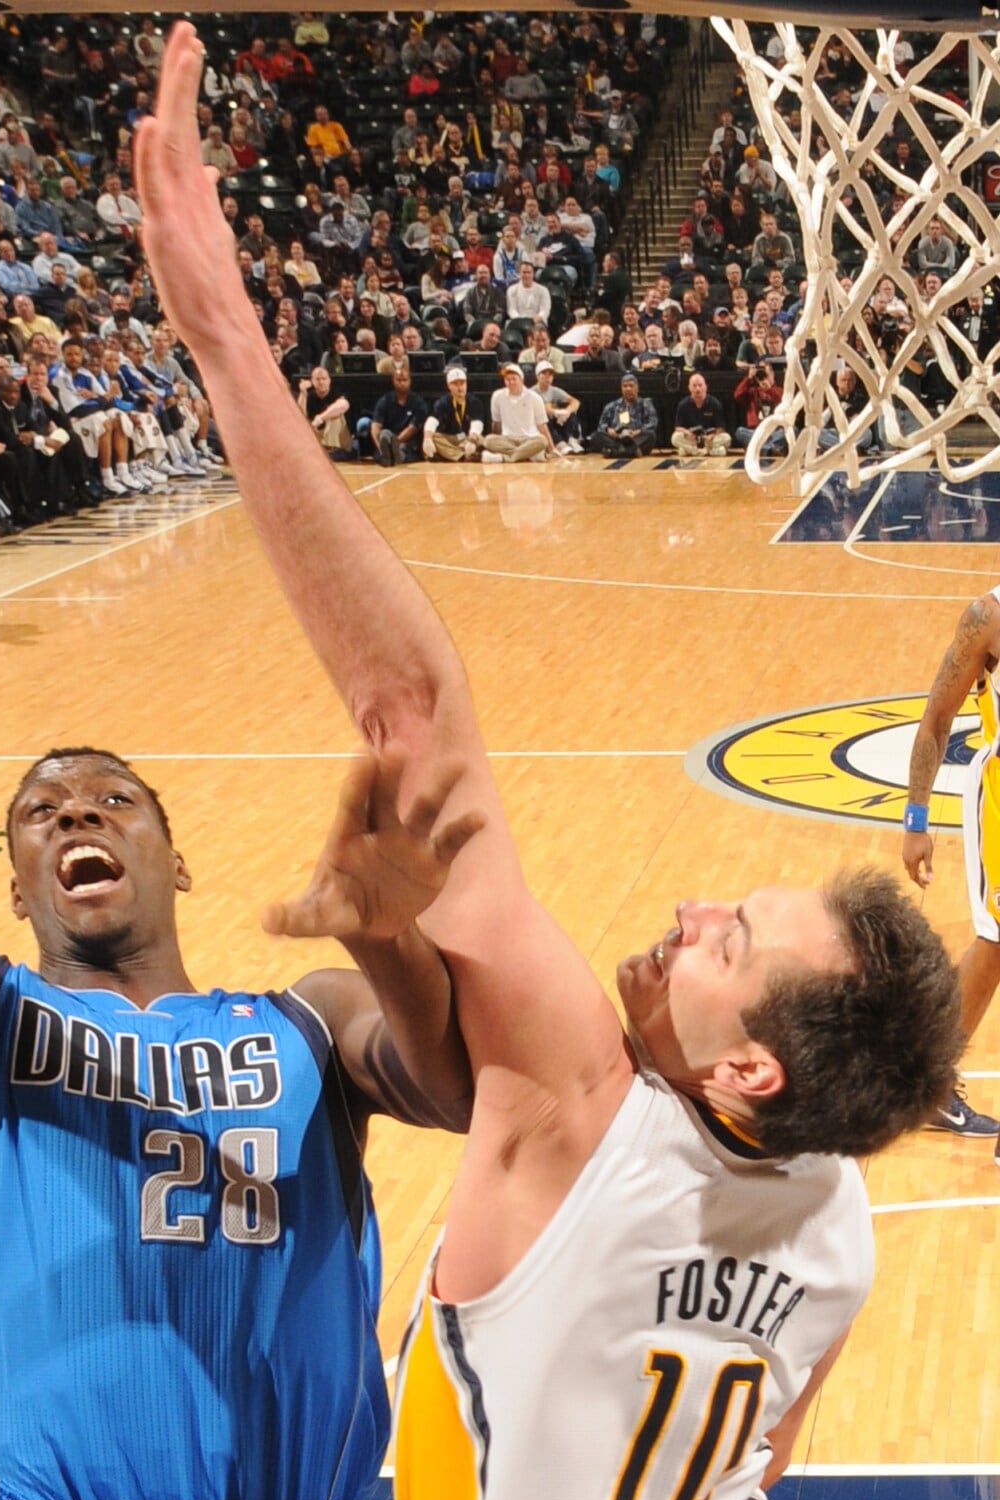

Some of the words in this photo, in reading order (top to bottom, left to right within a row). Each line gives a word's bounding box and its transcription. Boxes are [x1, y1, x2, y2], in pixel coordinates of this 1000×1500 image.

[10, 995, 282, 1118] DALLAS
[140, 1125, 281, 1245] 28
[656, 1255, 806, 1349] FOSTER
